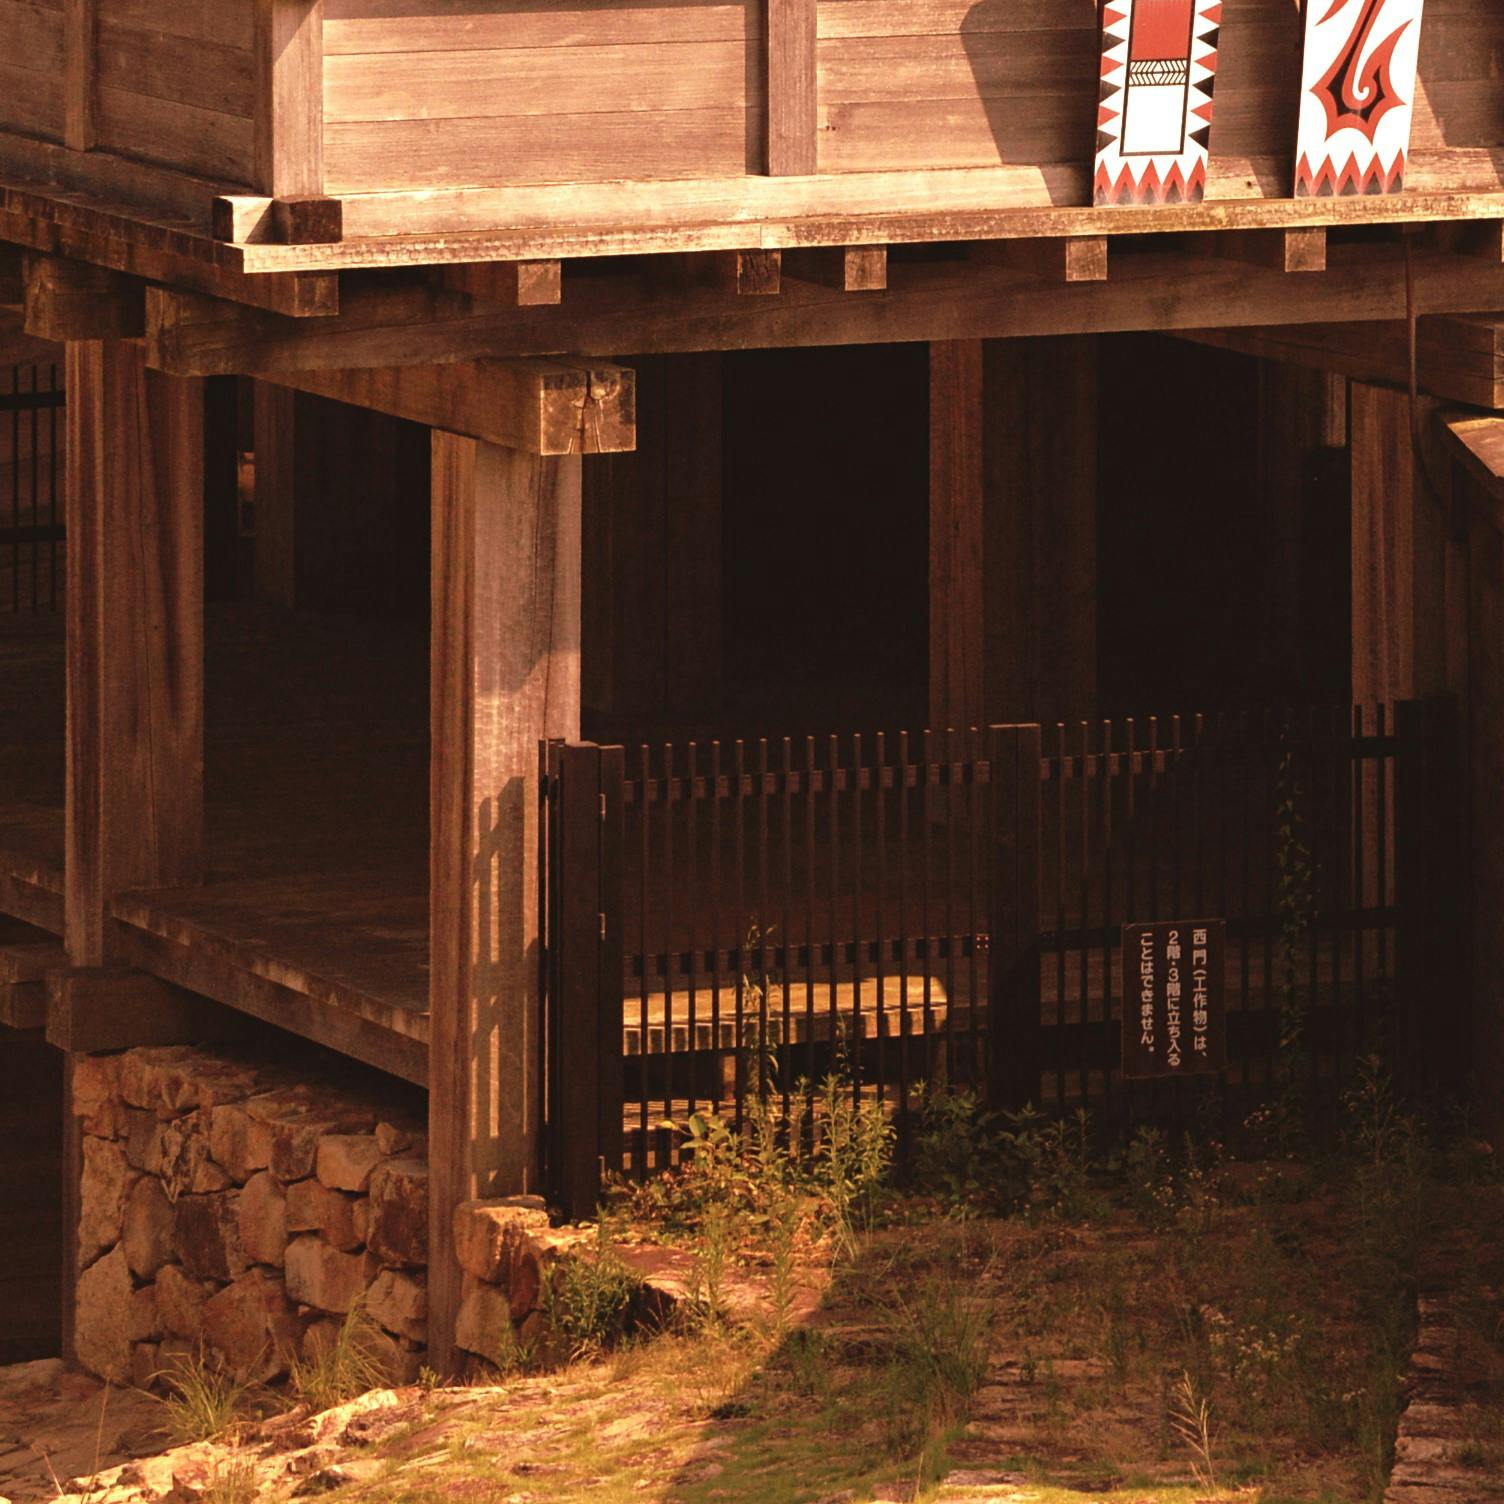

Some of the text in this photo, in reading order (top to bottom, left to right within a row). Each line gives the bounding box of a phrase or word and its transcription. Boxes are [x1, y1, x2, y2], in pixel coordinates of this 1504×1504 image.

[1140, 932, 1155, 1053] ことはできません。
